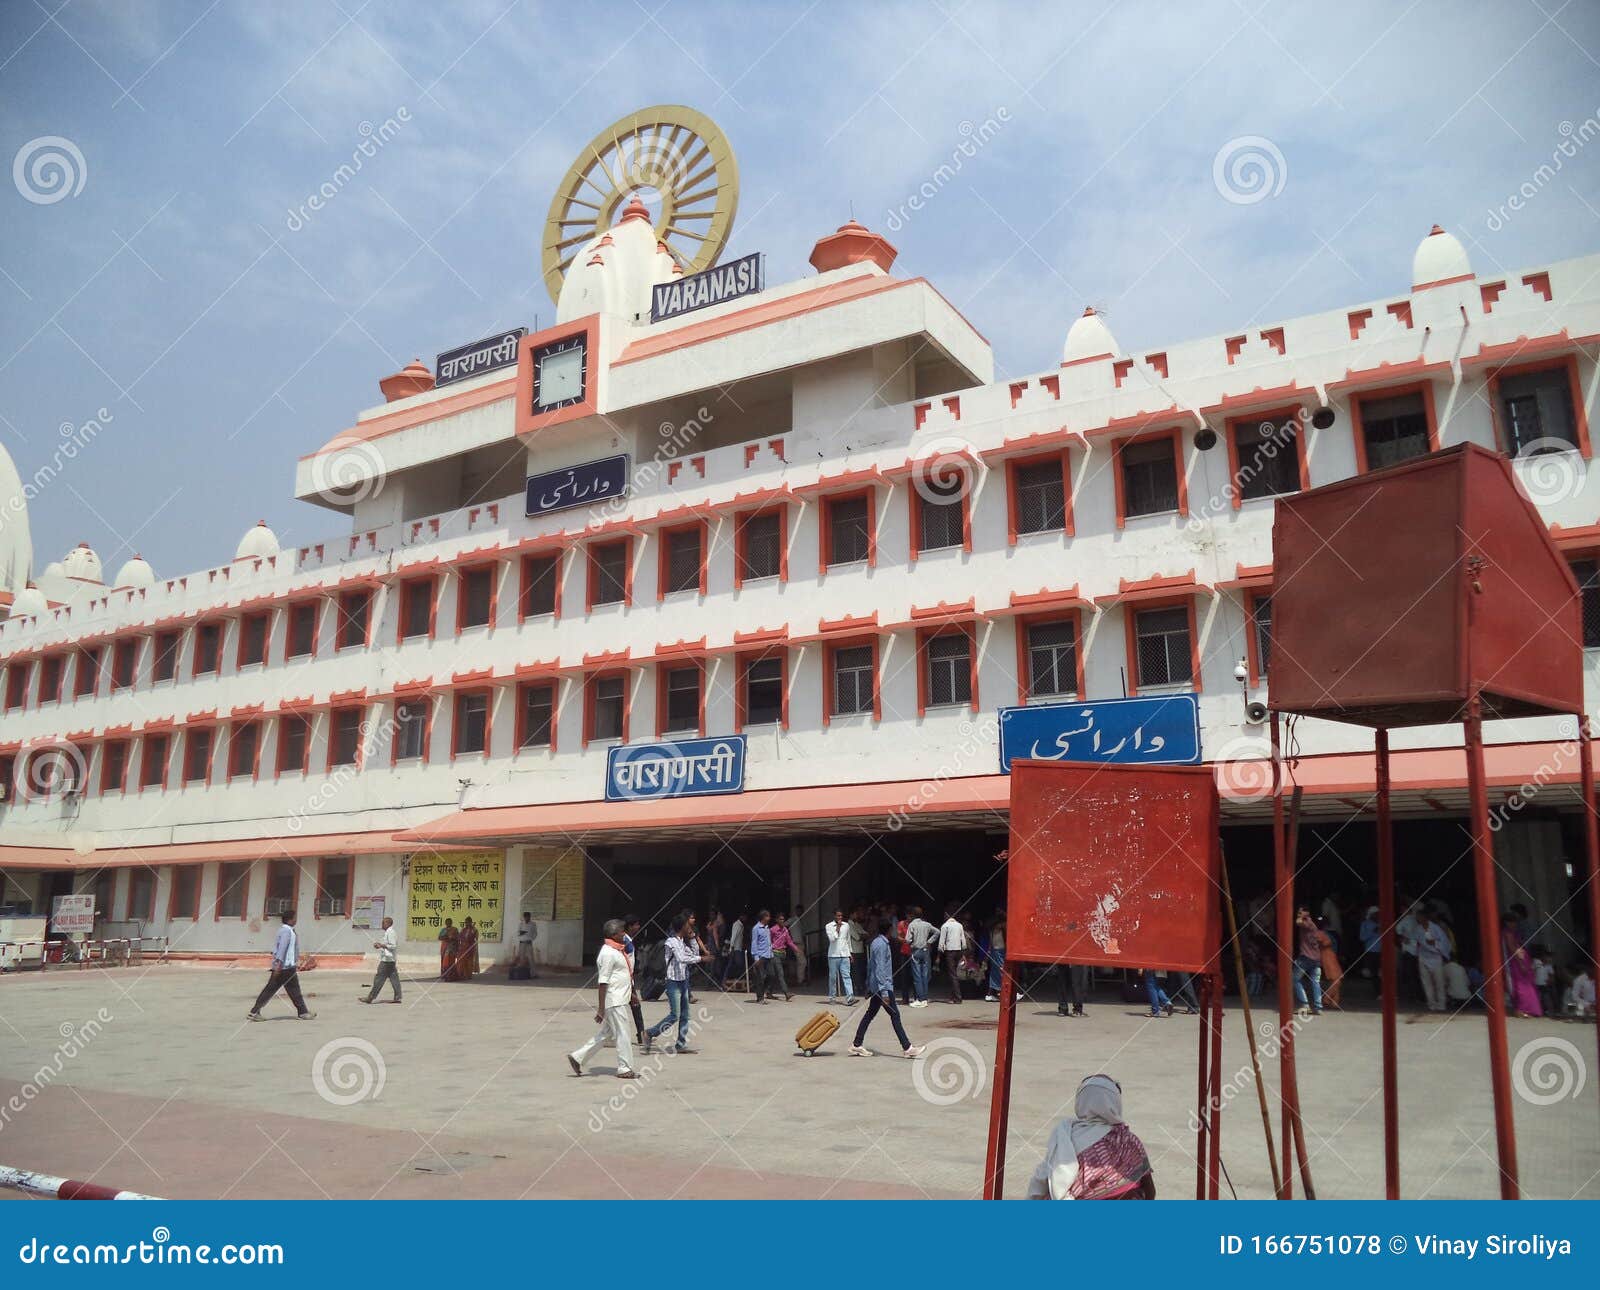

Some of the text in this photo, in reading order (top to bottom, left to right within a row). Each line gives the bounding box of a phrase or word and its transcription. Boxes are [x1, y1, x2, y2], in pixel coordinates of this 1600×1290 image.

[656, 258, 756, 316] VARANASI
[440, 334, 518, 378] वाराणसी
[615, 742, 735, 790] वाराणसी
[472, 881, 487, 891] आप
